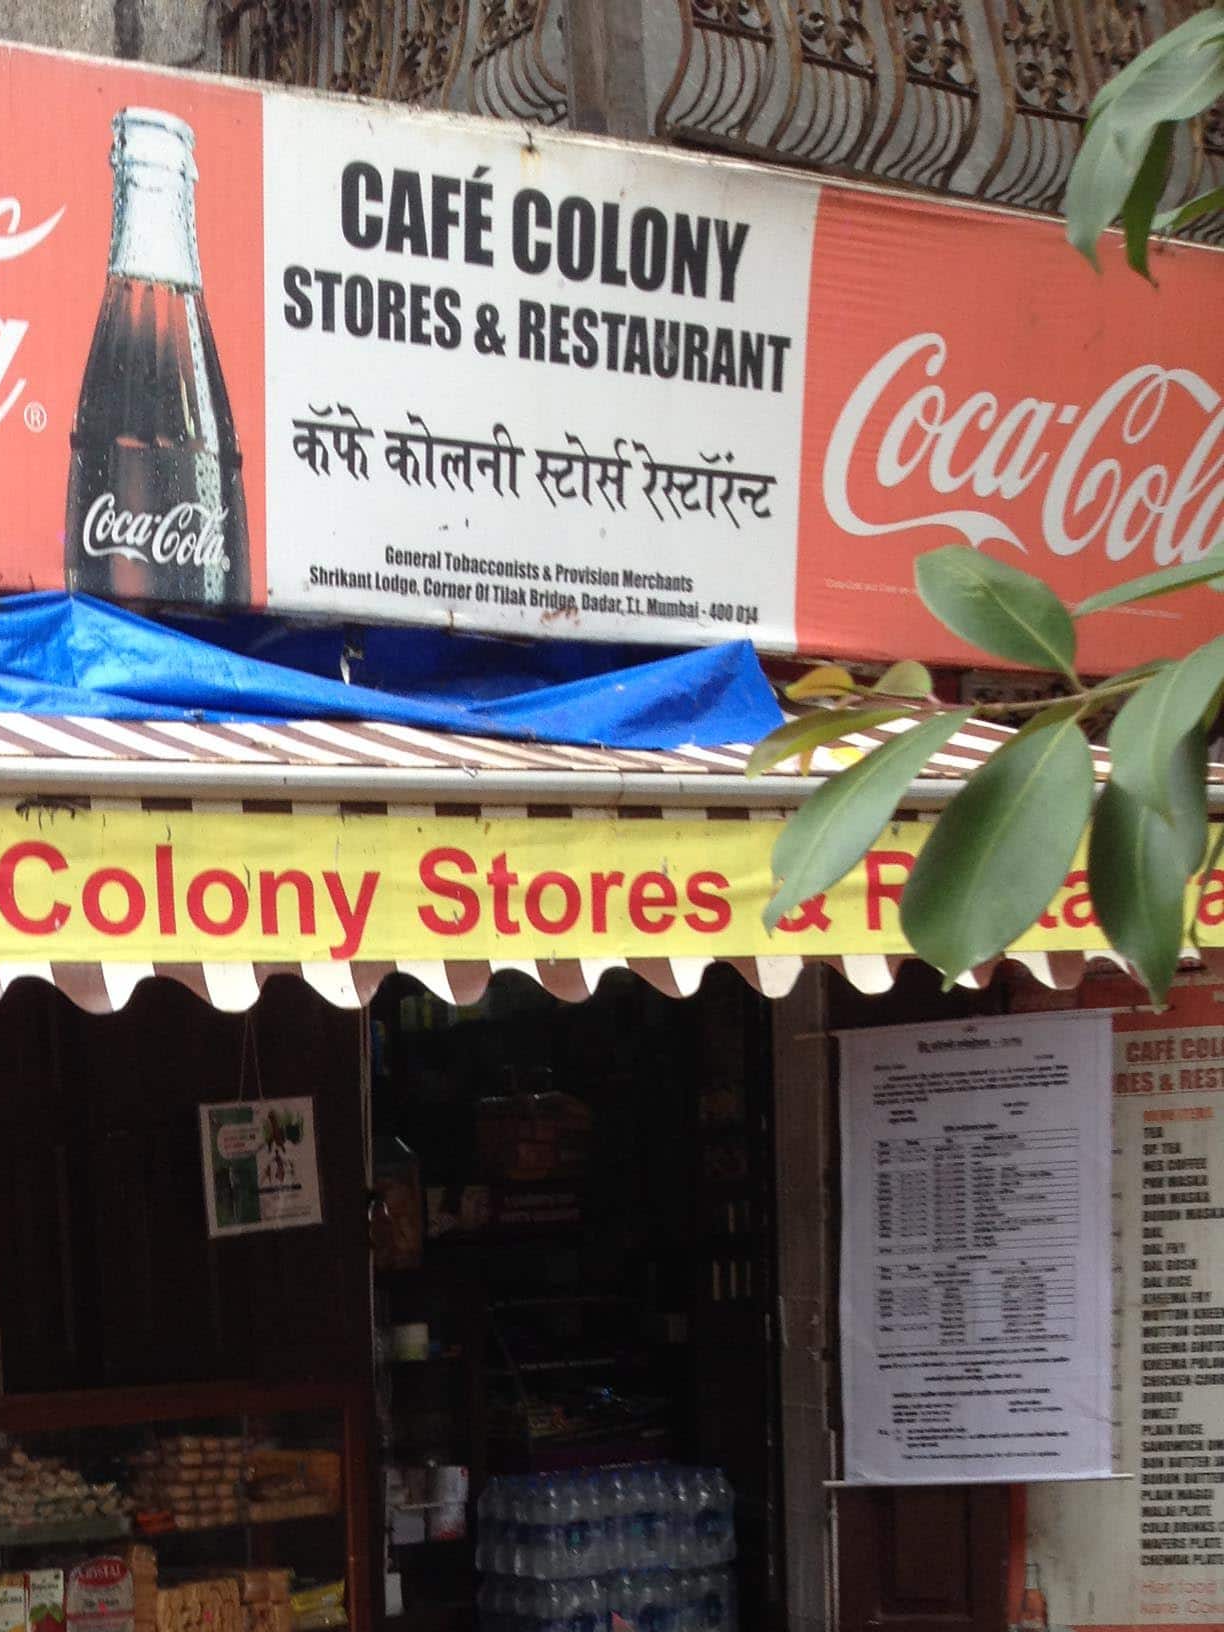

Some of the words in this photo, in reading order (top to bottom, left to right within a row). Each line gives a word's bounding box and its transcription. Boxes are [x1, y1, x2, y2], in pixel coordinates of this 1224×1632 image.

[341, 160, 494, 266] CAFÉ
[512, 187, 750, 305] COLONY
[284, 265, 462, 350] STORES
[473, 302, 506, 358] &
[519, 298, 792, 394] RESTAURANT
[83, 492, 229, 567] Coca-Cola
[309, 564, 373, 591] Shrikant
[423, 577, 472, 602] Corner
[476, 583, 490, 604] Of
[493, 585, 526, 607] Tilak
[646, 597, 699, 619] Mumbai
[709, 602, 733, 622] 400
[736, 605, 759, 625] 014
[385, 546, 441, 570] General
[445, 552, 539, 581] Tobacconists
[542, 566, 552, 581] &
[555, 563, 619, 587] Provision
[622, 569, 694, 593] Merchants
[417, 846, 733, 935] Stores
[1180, 1037, 1224, 1060] COL
